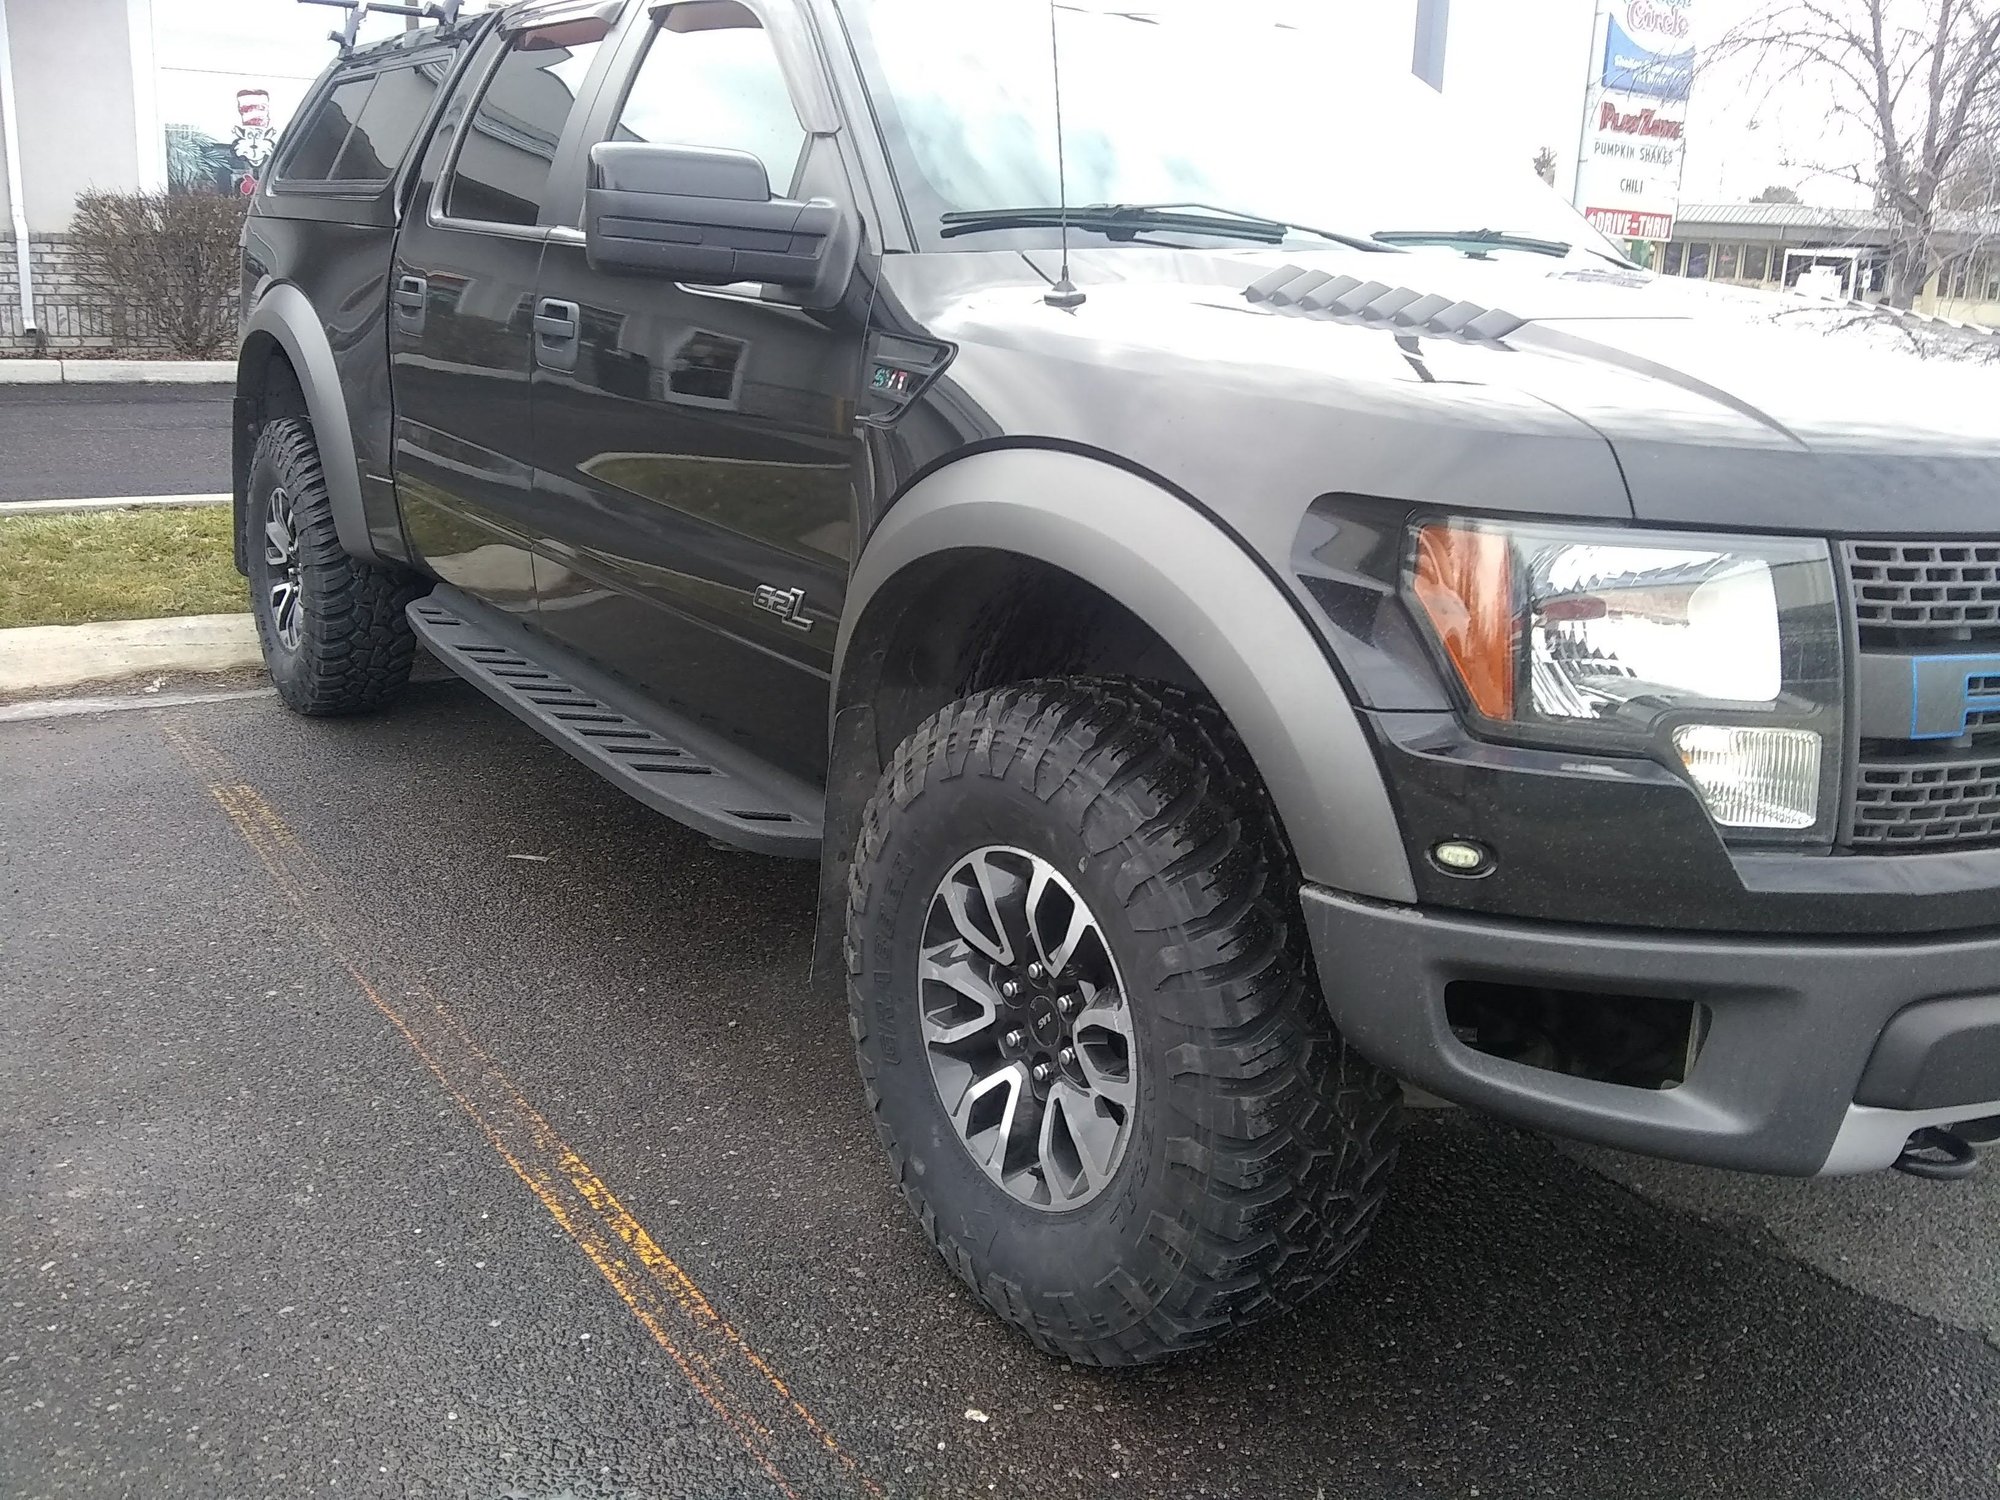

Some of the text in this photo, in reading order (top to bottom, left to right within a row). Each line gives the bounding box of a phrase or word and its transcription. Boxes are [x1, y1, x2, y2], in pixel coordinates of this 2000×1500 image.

[1594, 141, 1674, 166] PUMPKIN SHAKES
[1619, 178, 1643, 195] CHILI
[1595, 210, 1671, 240] DRIVE-THRU
